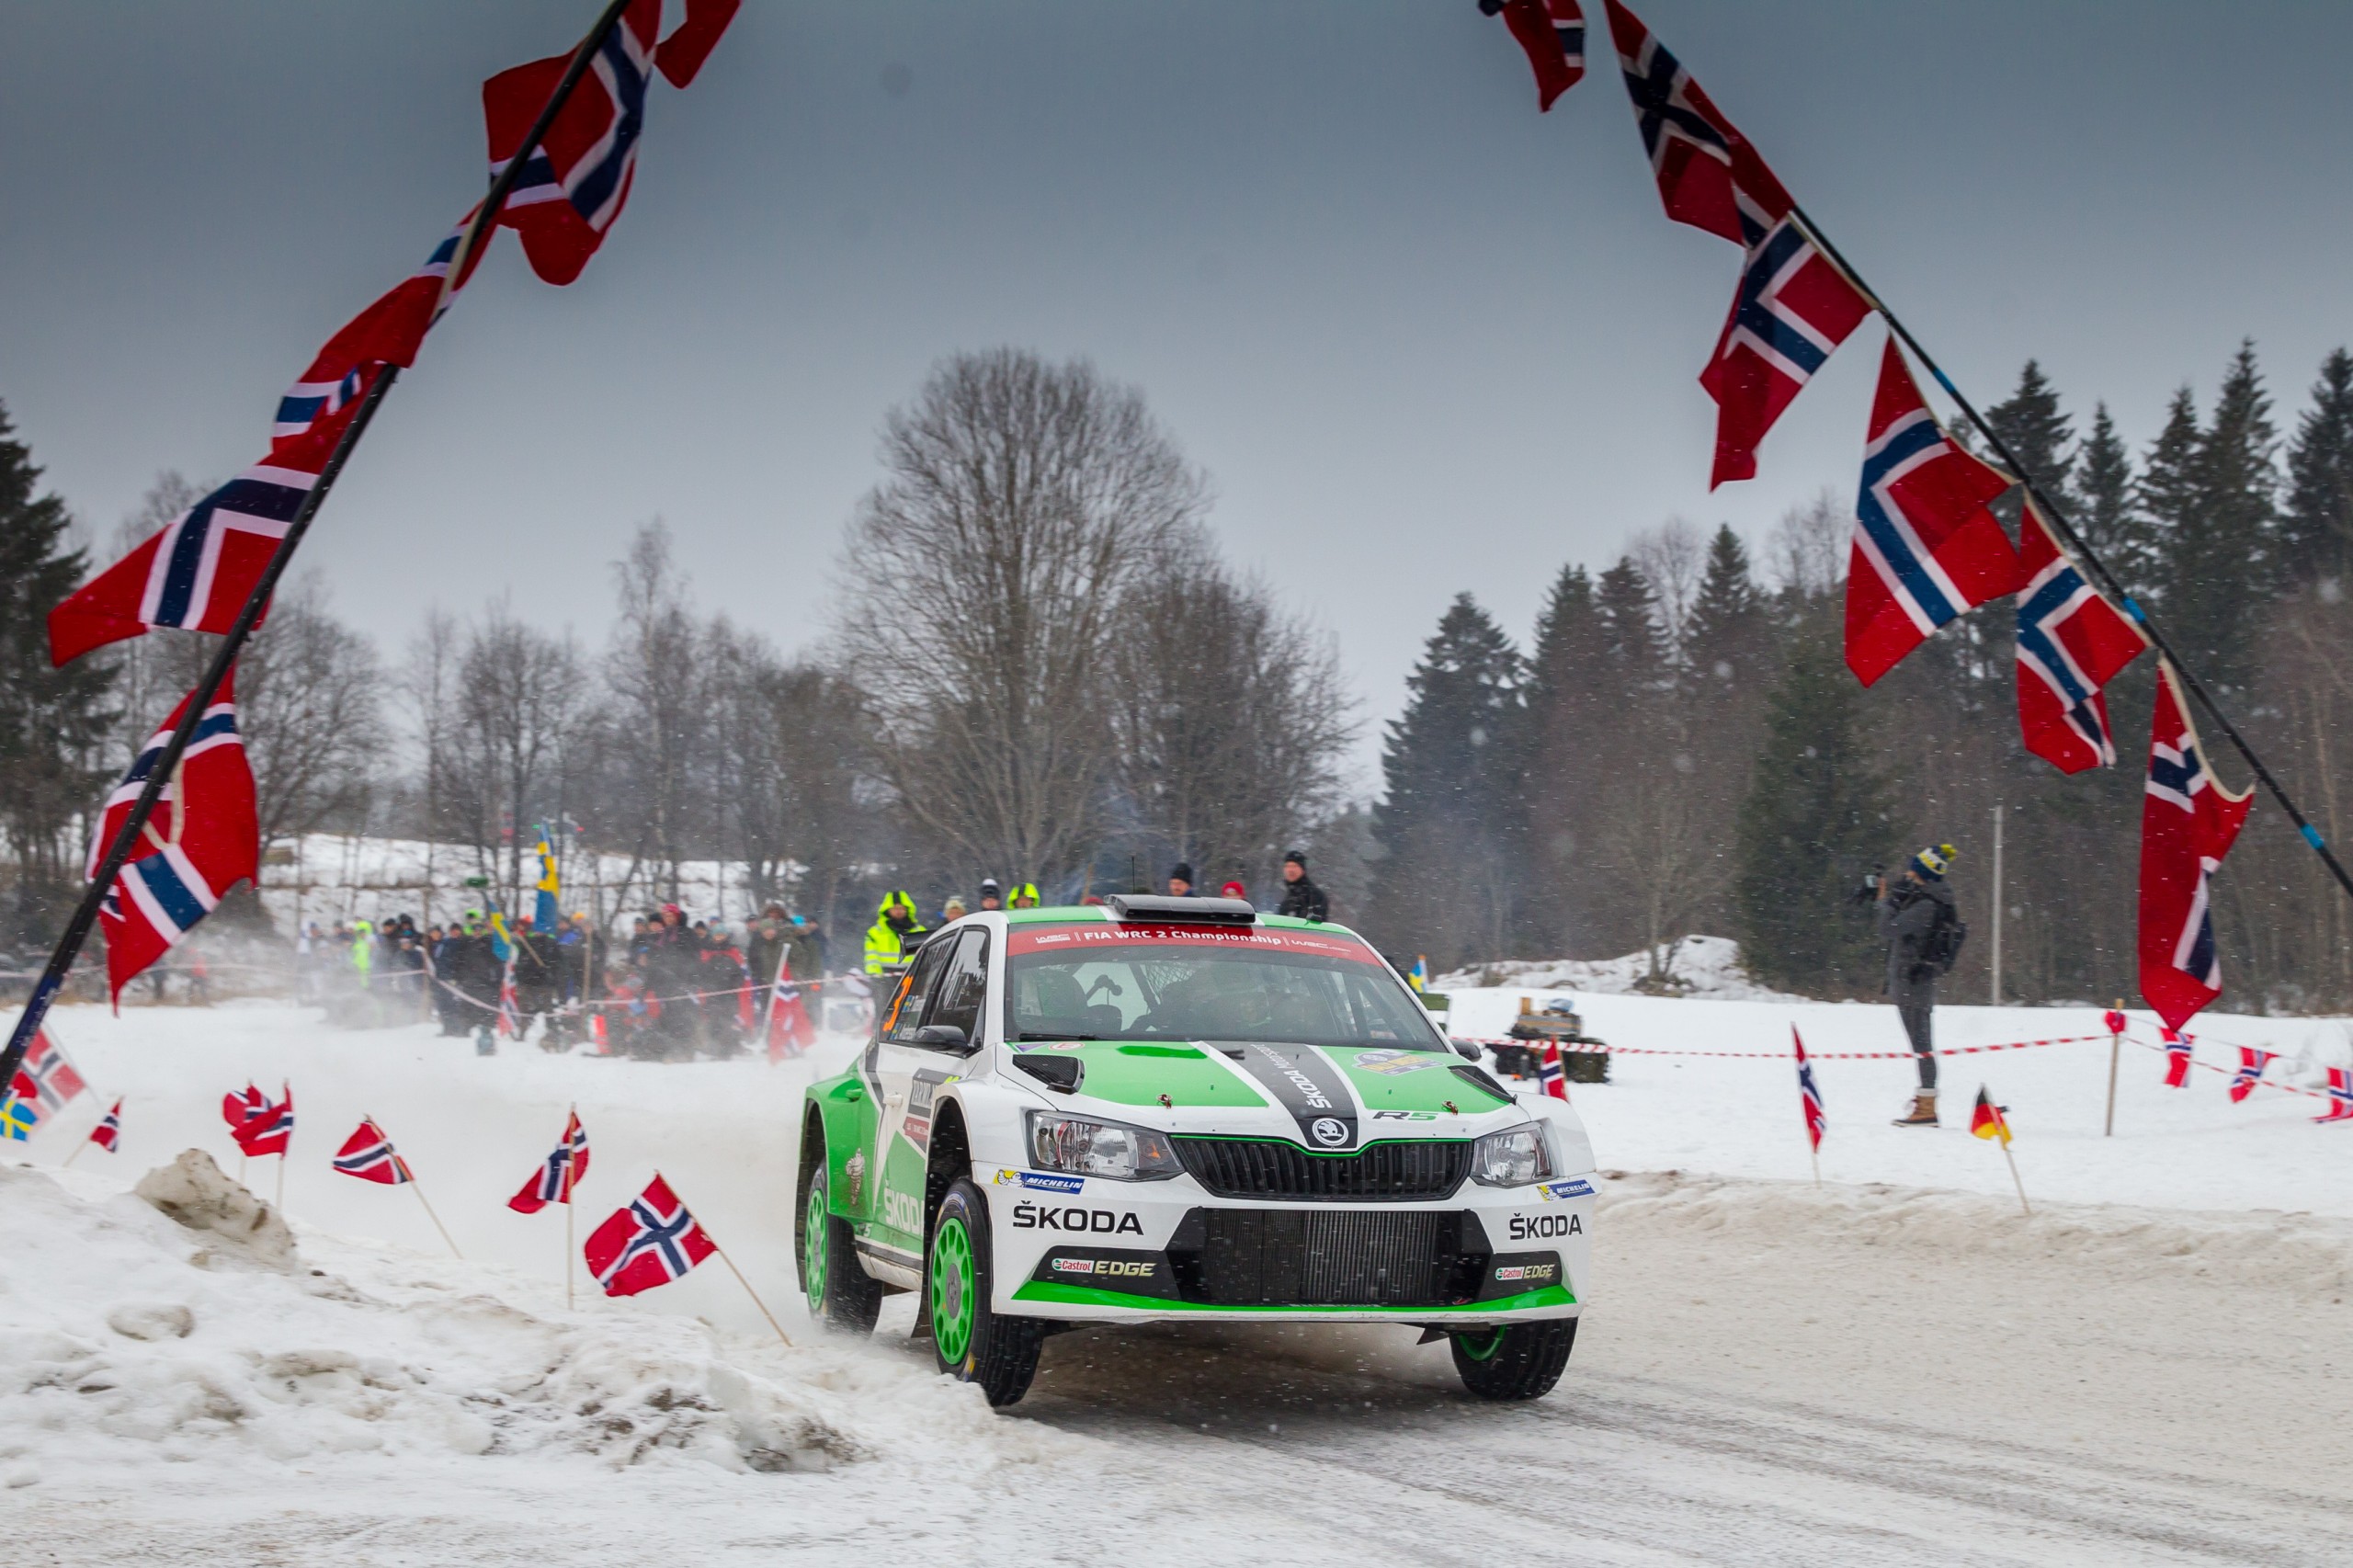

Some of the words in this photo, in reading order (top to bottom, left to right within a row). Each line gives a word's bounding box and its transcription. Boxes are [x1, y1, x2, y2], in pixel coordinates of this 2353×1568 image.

[1084, 932, 1113, 940] FIA
[1114, 930, 1151, 938] WRC
[1156, 930, 1167, 938] 2
[1171, 931, 1281, 946] Championship
[1284, 1070, 1333, 1108] ŠKODA
[1372, 1111, 1438, 1120] R5
[1027, 1176, 1084, 1189] MICHELIN
[1556, 1183, 1590, 1194] MICHELIN
[883, 1178, 924, 1237] ŠKOD
[1013, 1200, 1144, 1235] ŠKODA
[1509, 1212, 1583, 1240] ŠKODA
[1062, 1260, 1091, 1271] Castrol
[1094, 1260, 1157, 1277] EDGE
[1503, 1268, 1522, 1279] Castrol
[1523, 1264, 1555, 1279] EDGE
